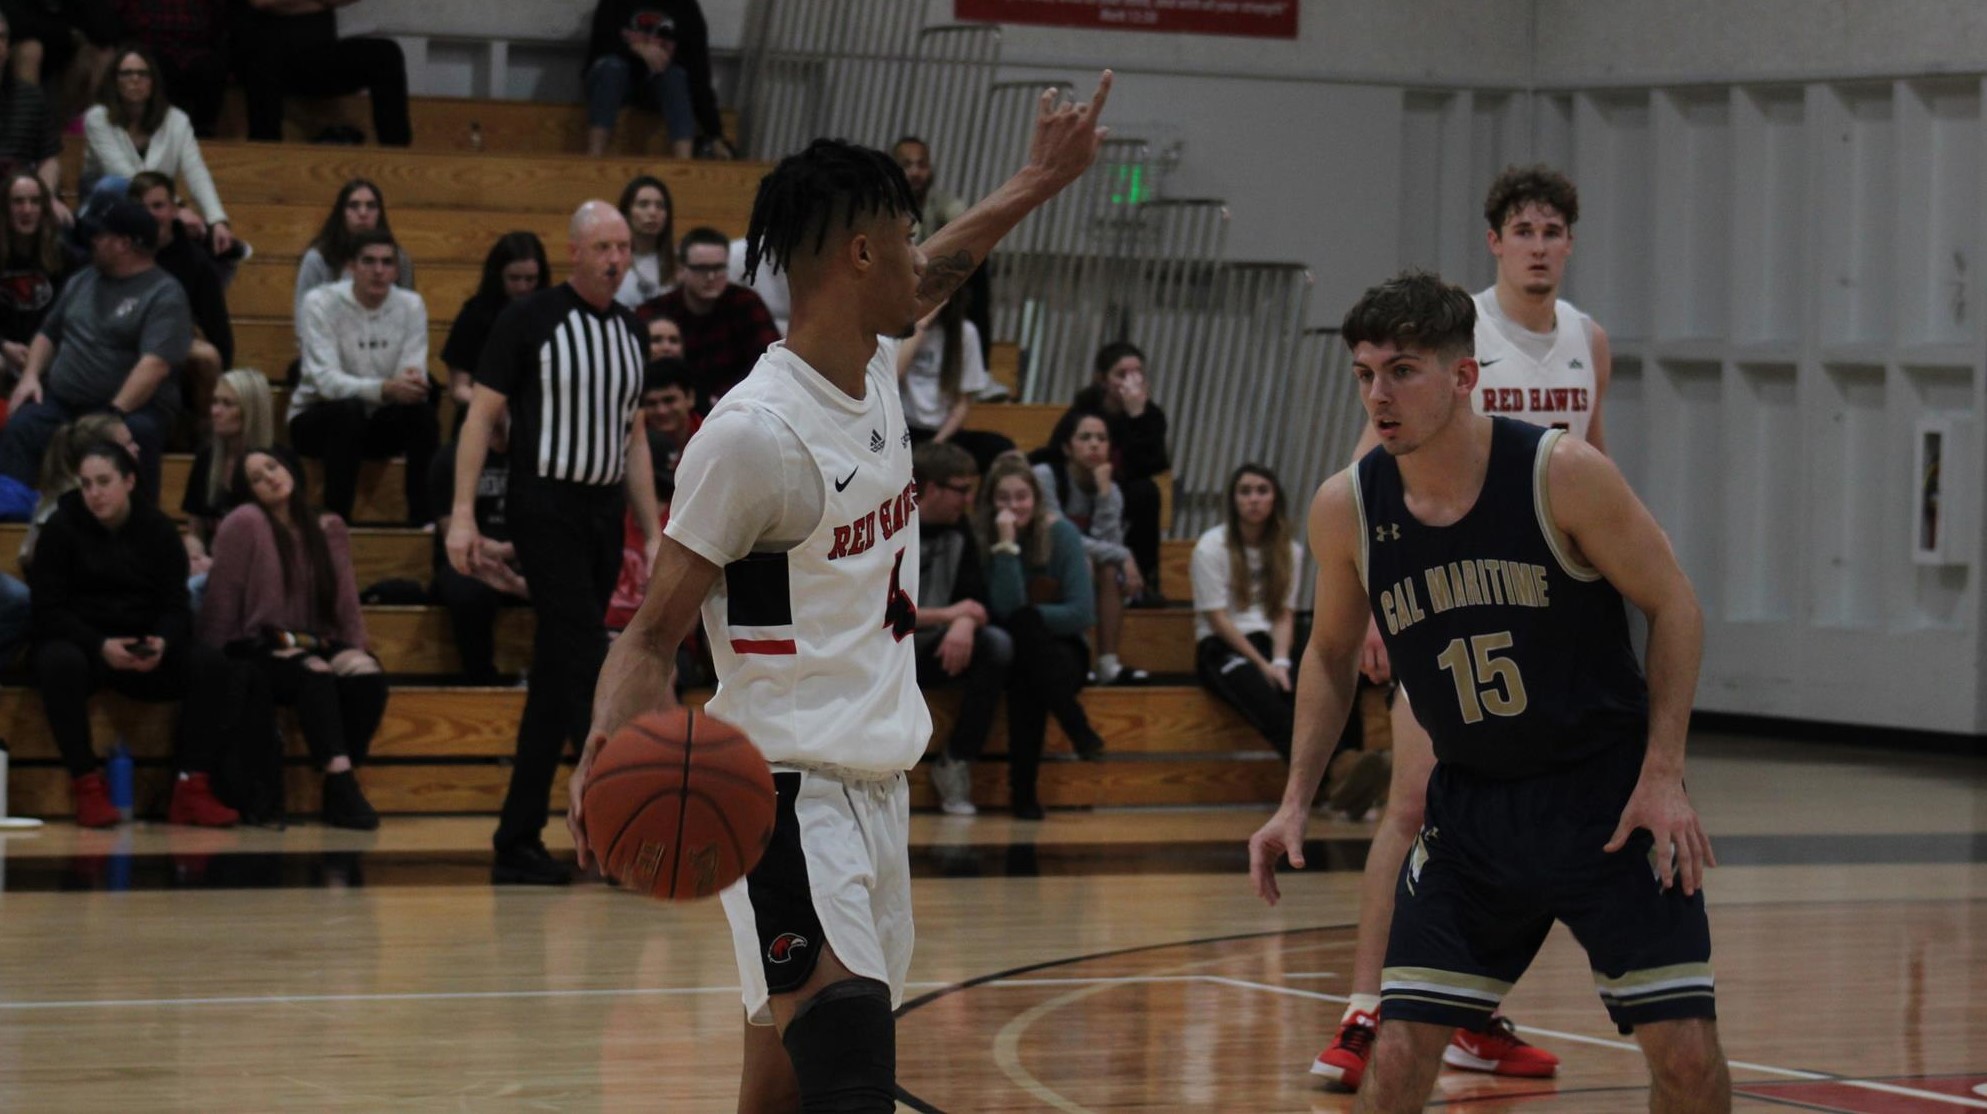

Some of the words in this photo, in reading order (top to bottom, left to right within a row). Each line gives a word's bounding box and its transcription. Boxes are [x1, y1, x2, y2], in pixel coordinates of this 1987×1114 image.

[1482, 388, 1524, 412] RED
[1529, 388, 1588, 412] HAWKS
[827, 510, 875, 561] RED
[1379, 576, 1426, 636] CAL
[1424, 558, 1550, 614] MARITIME
[1437, 630, 1528, 725] 15
